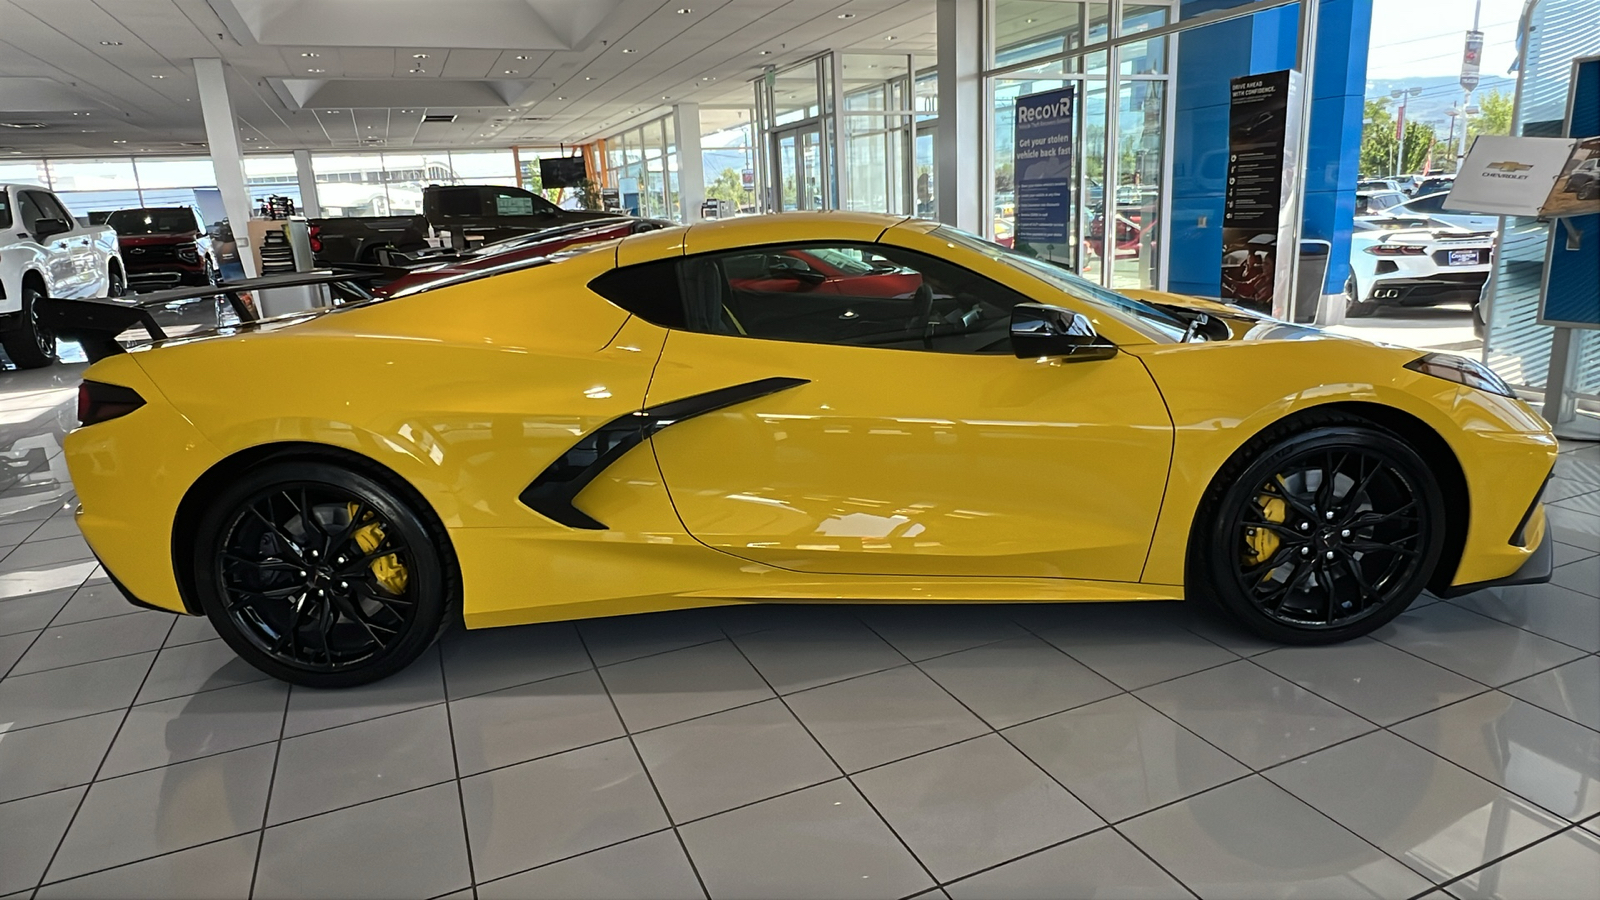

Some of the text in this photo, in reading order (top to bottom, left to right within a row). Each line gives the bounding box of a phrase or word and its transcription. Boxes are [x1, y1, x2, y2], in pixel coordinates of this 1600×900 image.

[1245, 86, 1276, 96] CONFIDENCE.
[1018, 98, 1071, 123] RecovR
[1019, 134, 1069, 148] Get your stolen
[1016, 146, 1071, 159] vehicle back fast
[1481, 172, 1529, 180] CHEVROLET
